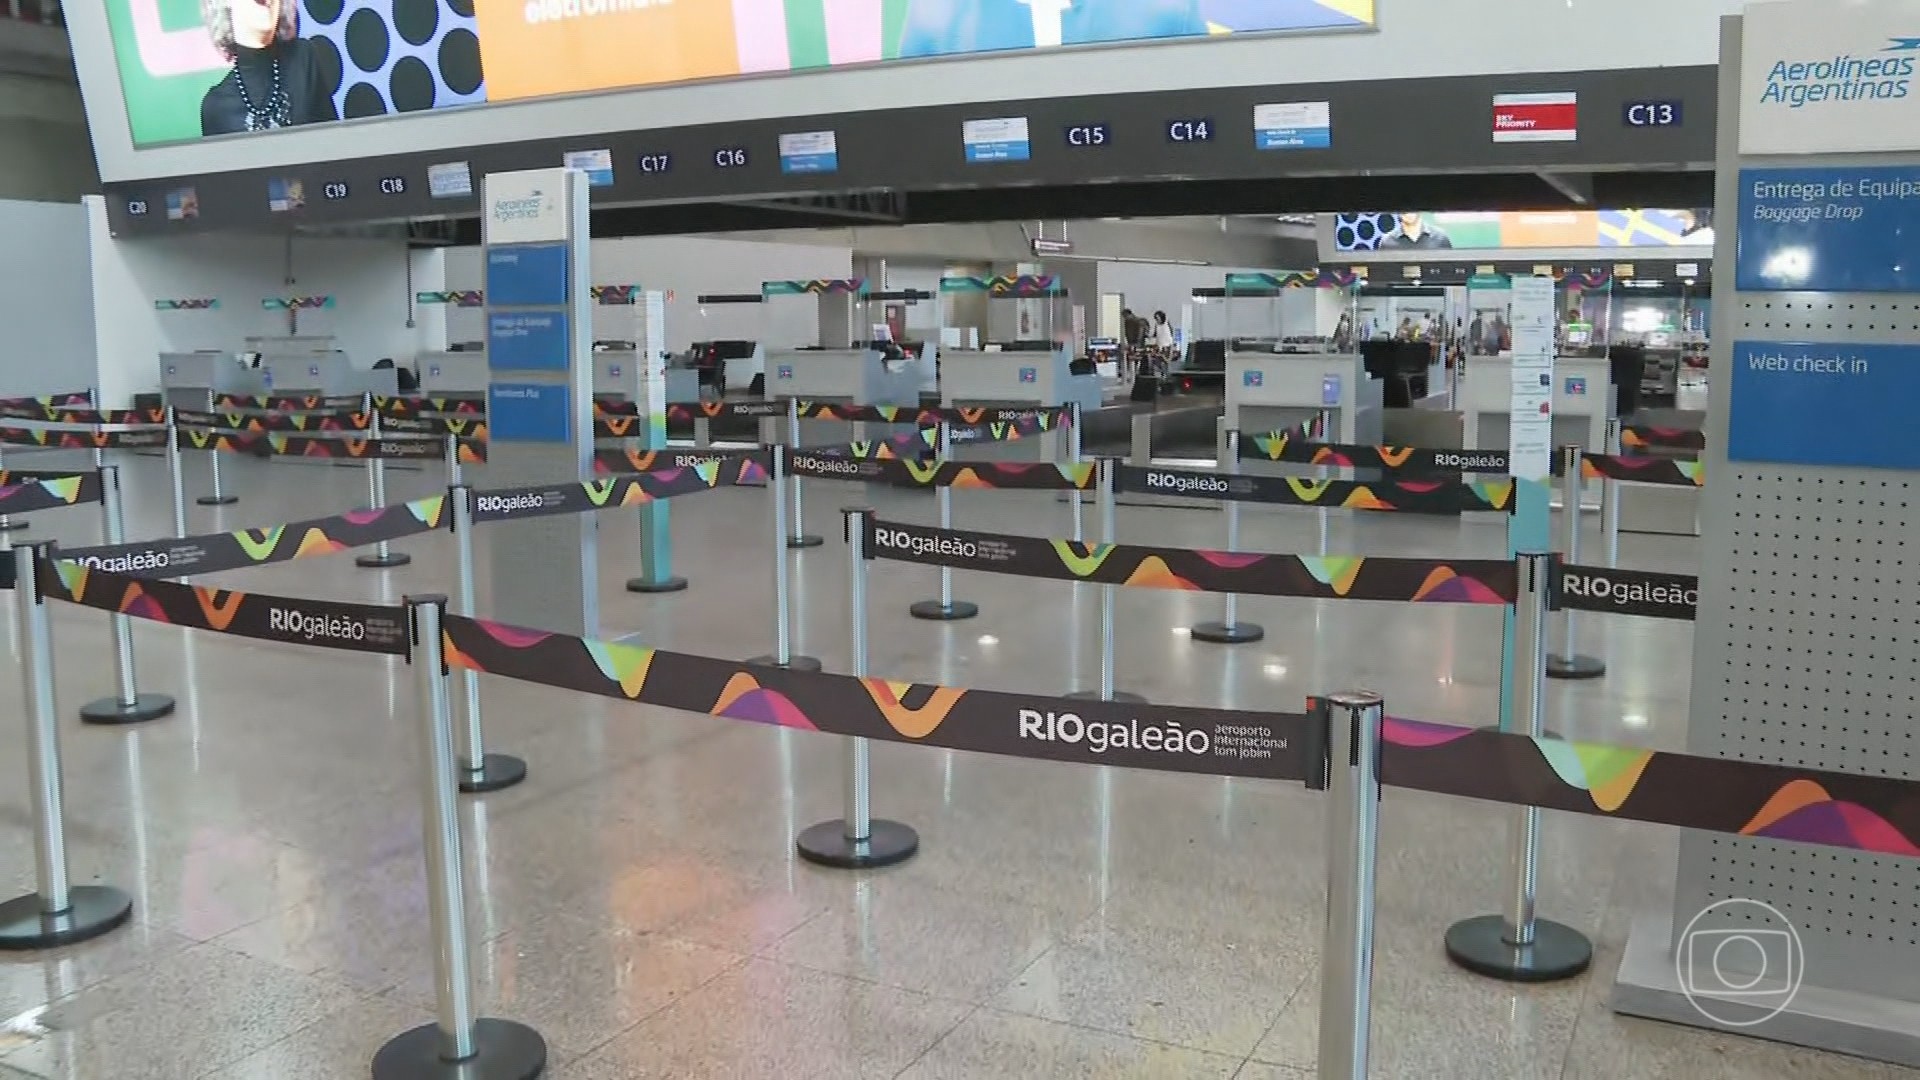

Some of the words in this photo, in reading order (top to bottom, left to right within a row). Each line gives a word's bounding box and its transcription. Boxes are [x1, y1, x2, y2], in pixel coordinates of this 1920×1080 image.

[1766, 54, 1916, 82] Aerolíneas
[1760, 79, 1910, 108] Argentinas
[1495, 120, 1536, 128] PRIORITY
[1627, 104, 1673, 125] C13
[1068, 126, 1105, 146] C15
[1170, 121, 1208, 141] C14
[640, 155, 668, 172] C17
[715, 149, 746, 166] C16
[324, 183, 347, 198] C19
[380, 178, 405, 194] C18
[1753, 181, 1826, 202] Entrega
[1829, 178, 1854, 197] de
[1858, 177, 1920, 201] Equipa
[1753, 204, 1822, 223] Baggage
[1824, 203, 1864, 222] Drop
[1748, 352, 1789, 371] Web
[1792, 354, 1846, 373] check
[1850, 356, 1869, 374] in
[792, 456, 859, 474] RIOgaleão
[1434, 453, 1505, 469] RIOgaleão
[1147, 473, 1229, 492] RIOgaleão
[477, 493, 543, 513] RIOgaleão
[874, 527, 977, 558] RIOgaleão
[269, 607, 365, 641] RIOgaleão
[1018, 709, 1210, 755] RIOgaleão
[1214, 724, 1272, 738] aeroporto
[1214, 734, 1288, 749] internacional
[1214, 746, 1238, 757] tom
[1238, 748, 1272, 760] jobim
